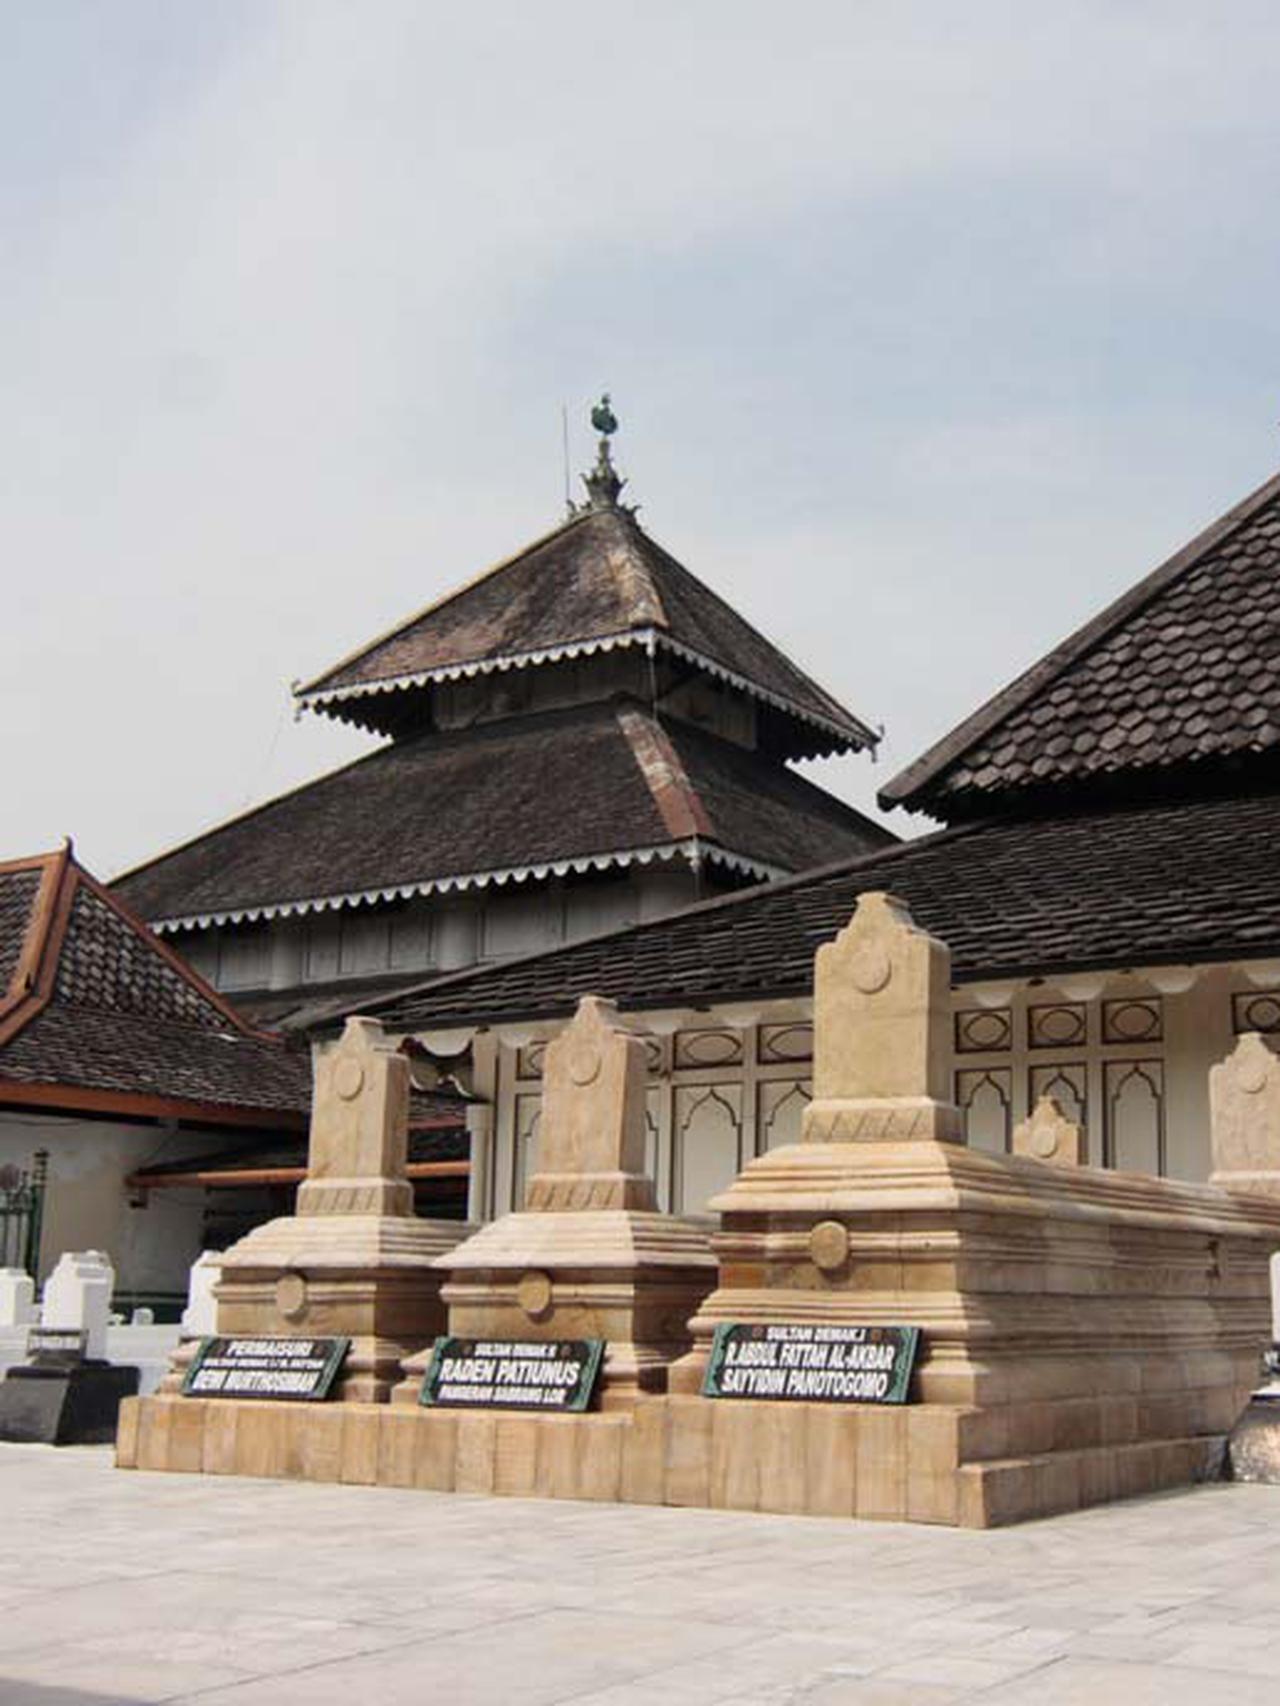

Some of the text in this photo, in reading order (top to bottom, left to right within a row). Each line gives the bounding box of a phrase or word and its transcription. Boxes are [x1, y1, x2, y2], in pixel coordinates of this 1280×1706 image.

[779, 1343, 829, 1368] FATTAH
[827, 1345, 896, 1370] AL-AKBAR
[439, 1358, 581, 1385] RADEN PATIUNUS
